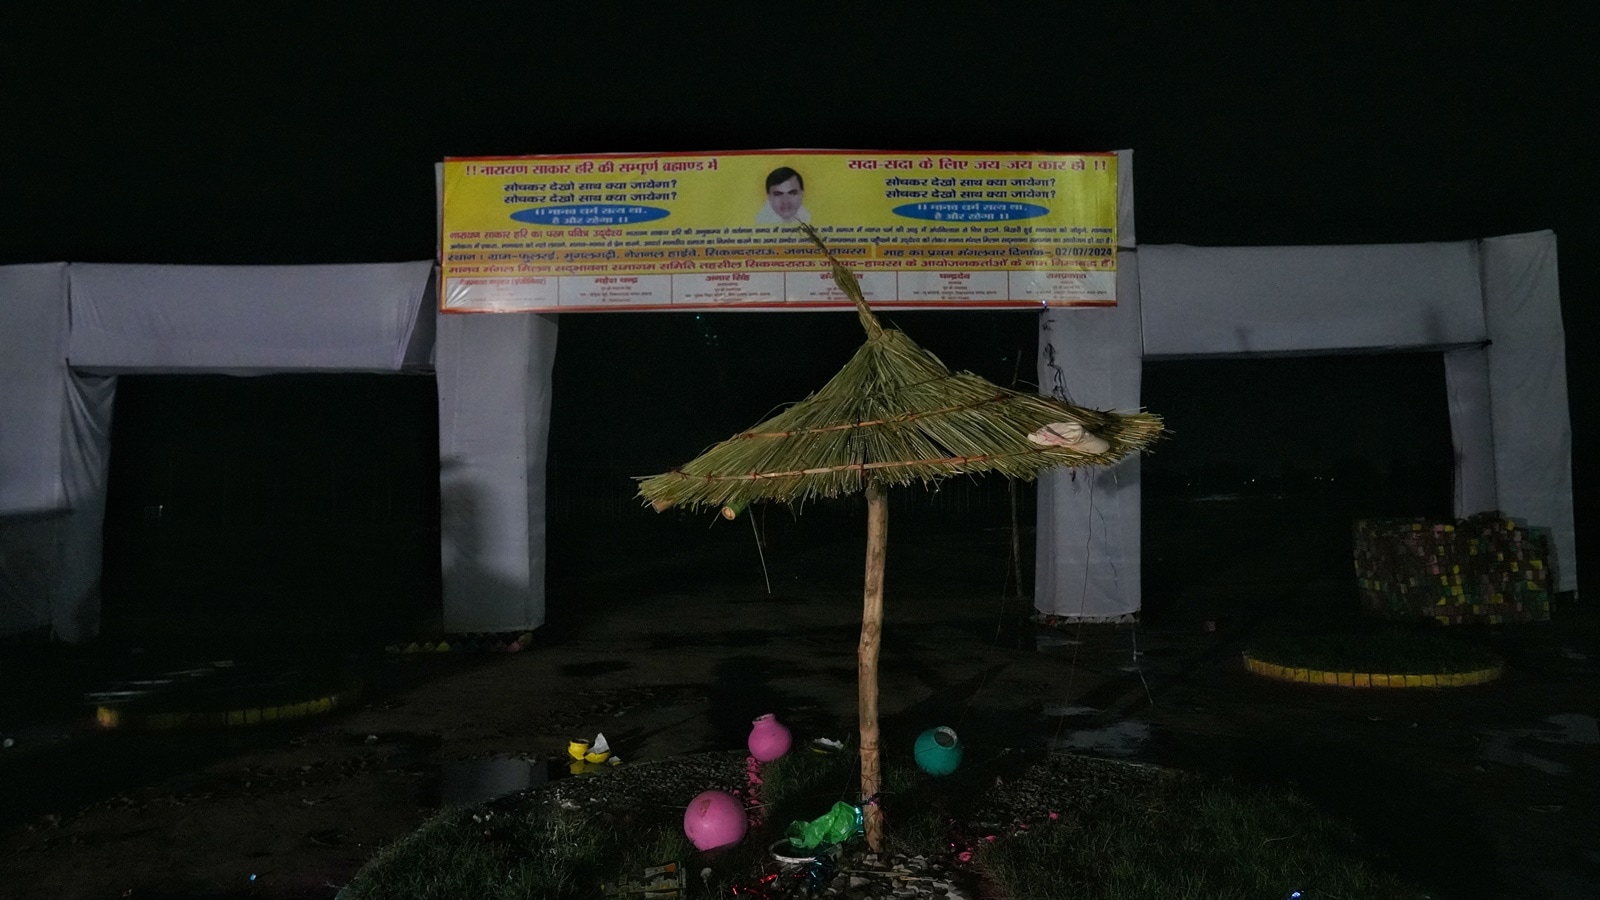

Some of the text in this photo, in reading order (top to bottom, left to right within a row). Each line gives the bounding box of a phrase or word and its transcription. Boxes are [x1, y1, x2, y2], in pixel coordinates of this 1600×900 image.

[481, 166, 528, 175] नारायण
[532, 164, 570, 174] साकार
[575, 161, 594, 174] हरि
[598, 160, 614, 173] की
[619, 160, 658, 175] सम्पूर्ण
[708, 158, 718, 170] में
[918, 158, 933, 170] के
[939, 158, 968, 170] लिए
[1038, 160, 1064, 170] कार
[1071, 158, 1086, 170] हो
[504, 180, 677, 192] सोचकर देखो साथ क्या जायेगा?
[886, 176, 1056, 186] सोचकर देखो साथ क्या जायेगा?
[504, 191, 677, 204] सोचकर देखो साथ क्या जायेगा?
[886, 188, 1056, 198] सोचकर देखो साथ क्या जायेगा?
[484, 230, 510, 239] साकार
[514, 228, 528, 238] हरि
[530, 230, 542, 238] का
[1055, 247, 1112, 256] 02/07/2024
[449, 265, 480, 273] मानव
[660, 260, 696, 270] समिति
[906, 259, 917, 267] के
[1011, 258, 1022, 267] के
